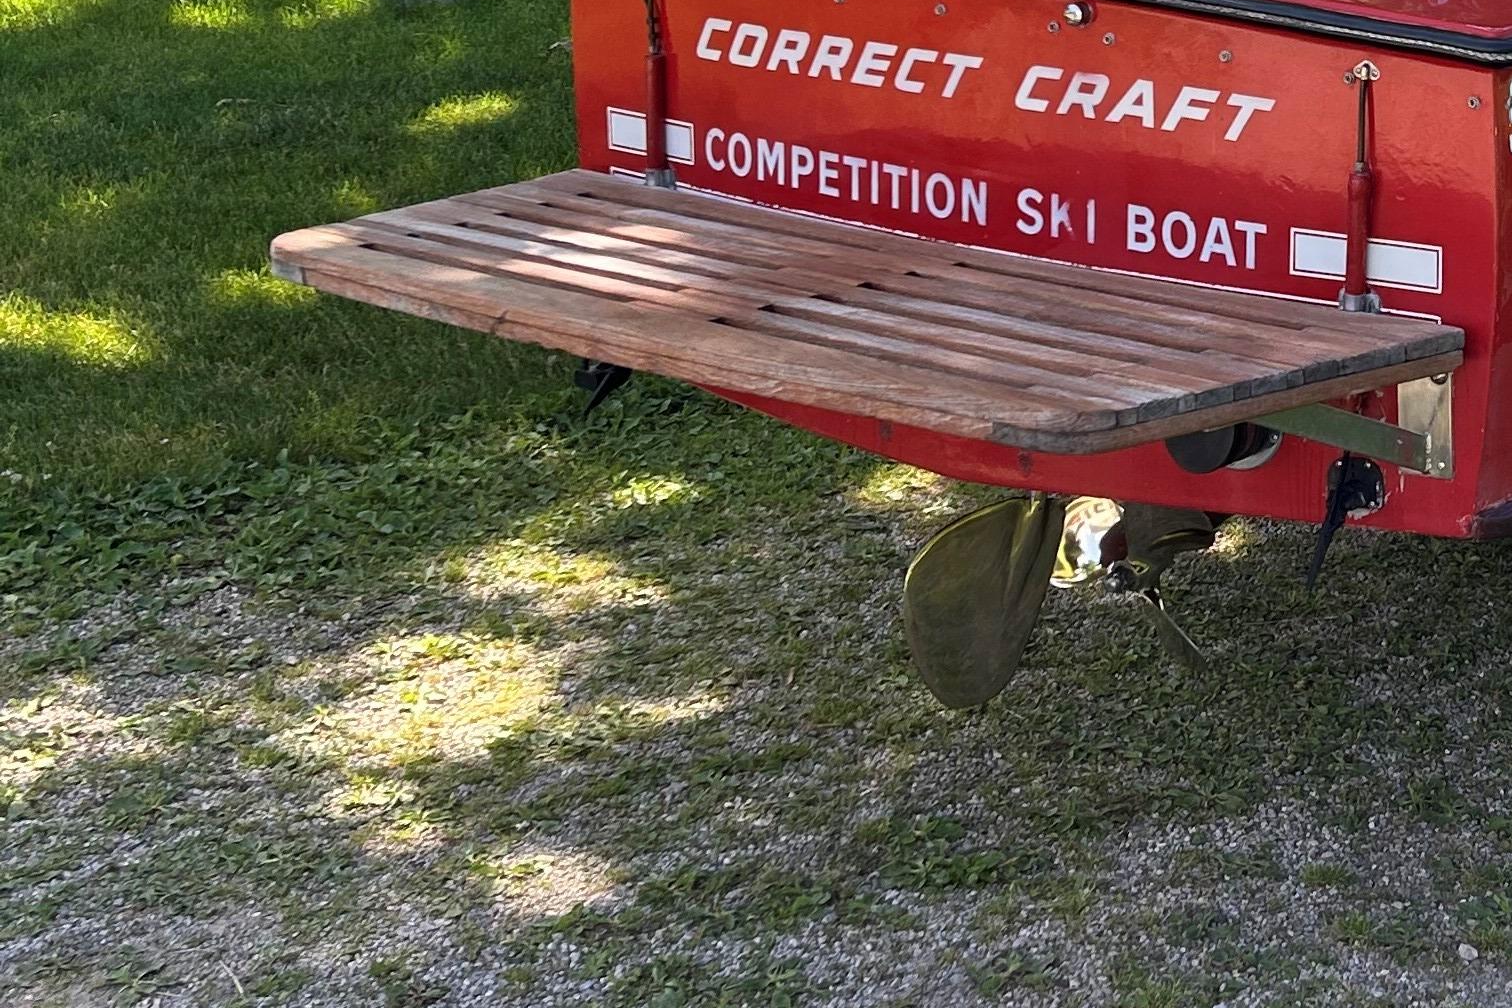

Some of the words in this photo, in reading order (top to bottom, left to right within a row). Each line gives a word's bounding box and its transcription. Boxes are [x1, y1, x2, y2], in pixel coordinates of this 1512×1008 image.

[695, 17, 984, 99] CORRECT
[1013, 65, 1277, 143] CRAFT
[704, 127, 989, 227] COMPETITION
[1016, 187, 1096, 245] SKI
[1127, 203, 1269, 271] BOAT
